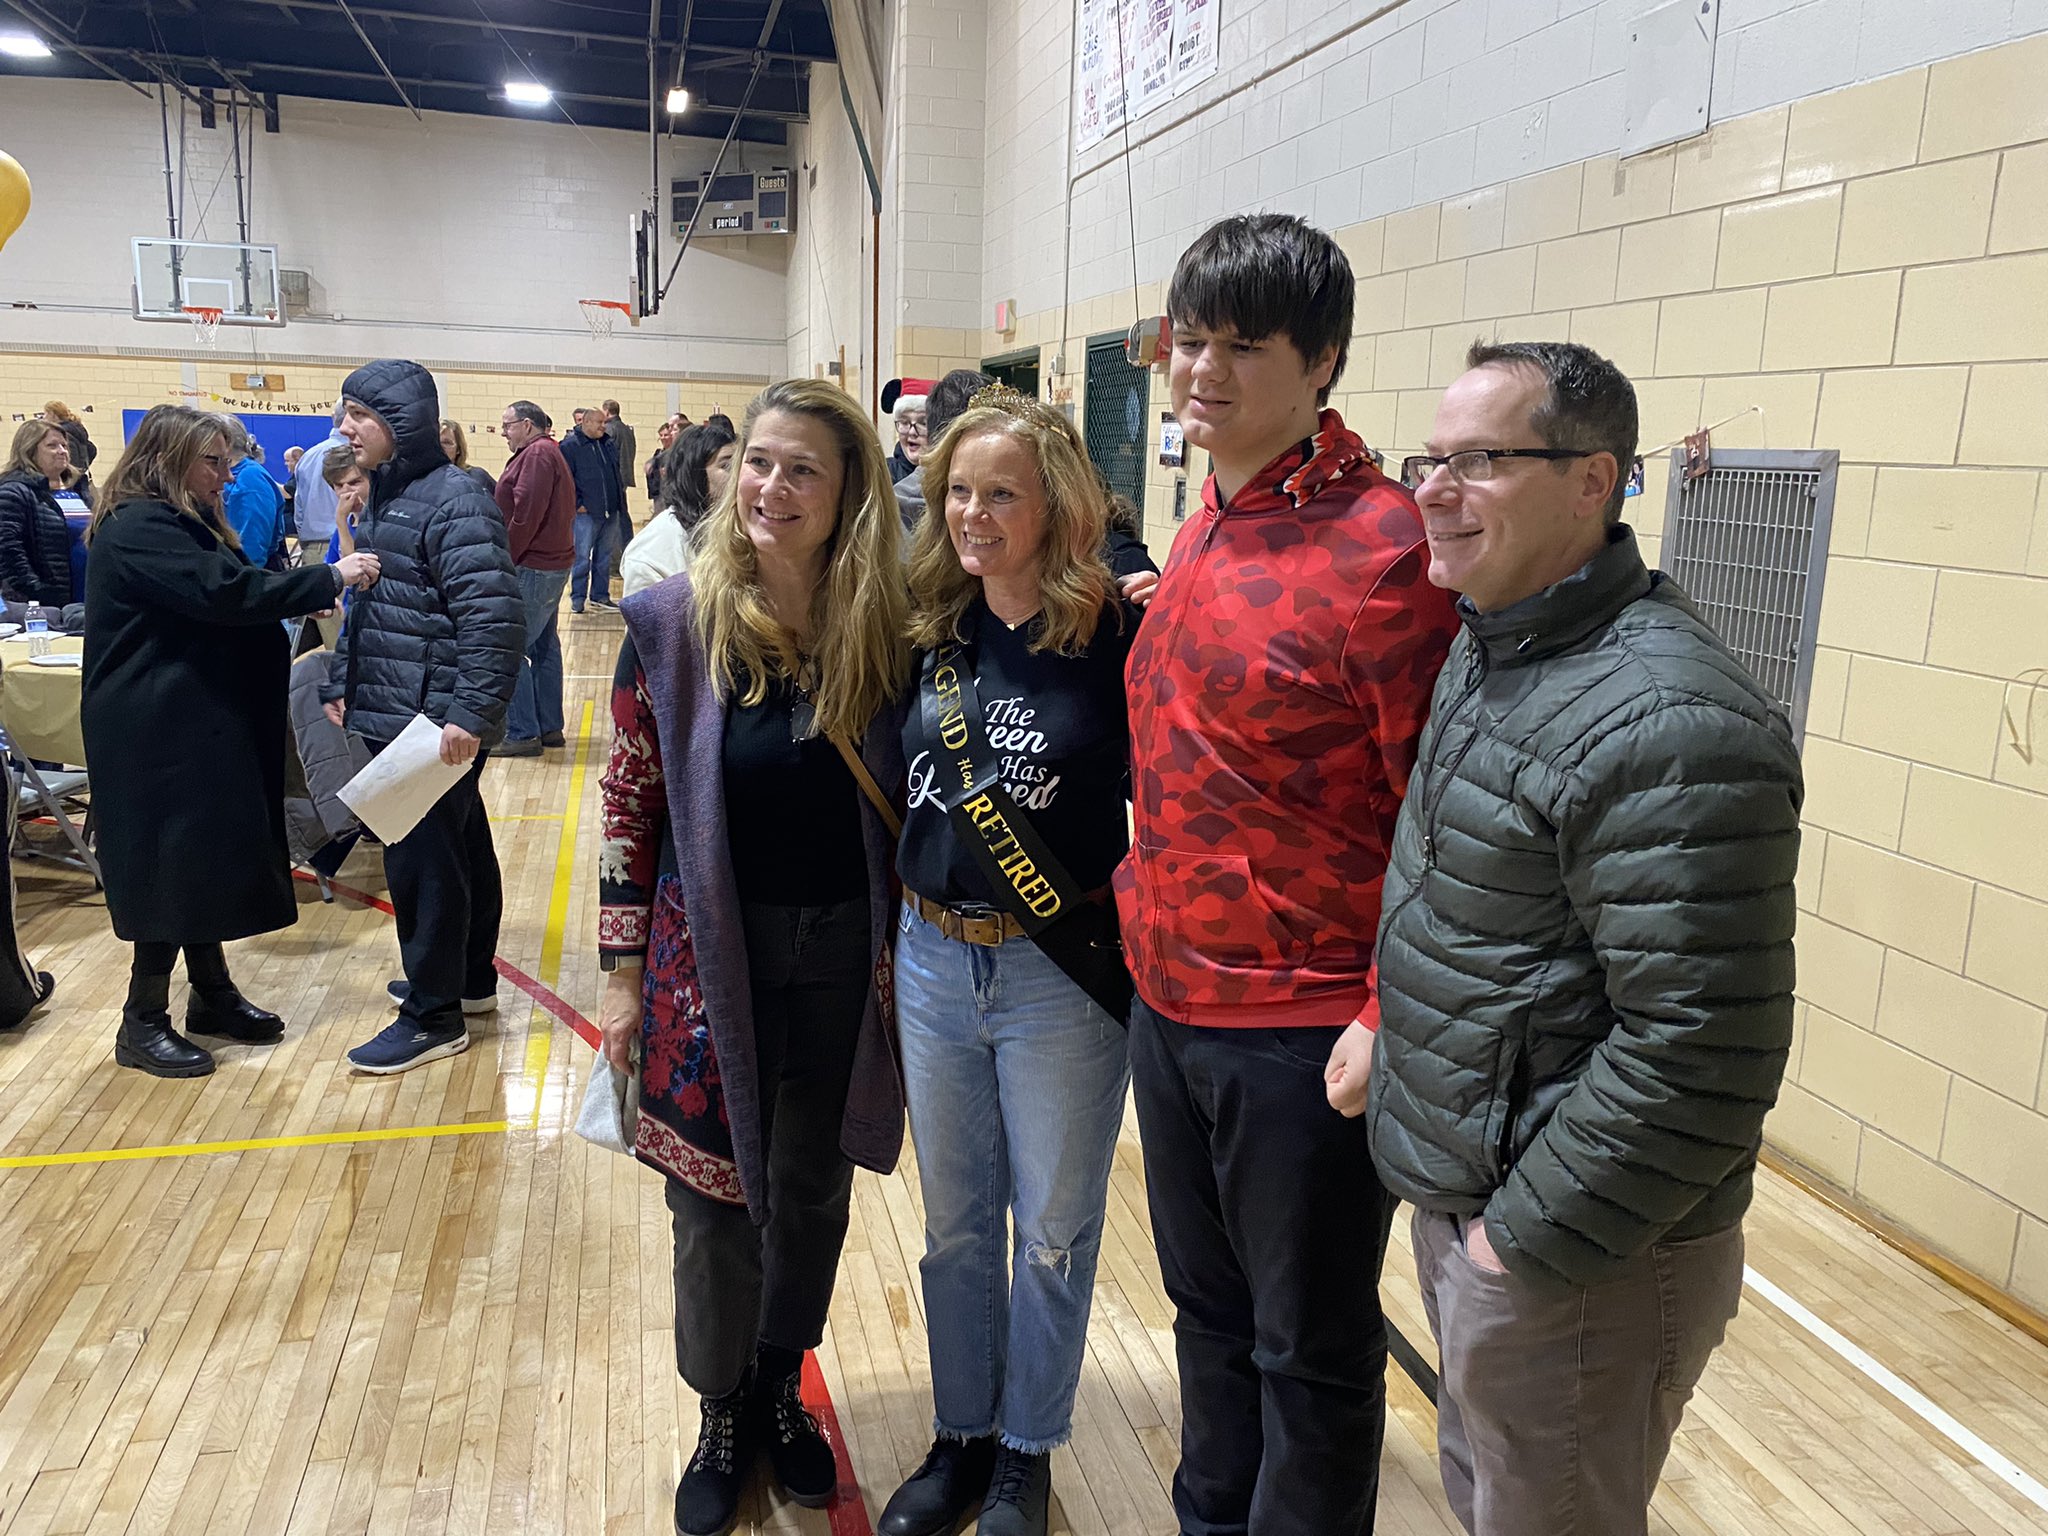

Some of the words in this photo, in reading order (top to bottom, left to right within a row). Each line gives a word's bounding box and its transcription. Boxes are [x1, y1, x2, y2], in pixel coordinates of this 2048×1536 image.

[760, 177, 785, 188] Guests
[716, 216, 739, 229] period
[223, 397, 238, 405] we
[241, 400, 272, 411] will
[278, 402, 300, 413] miss
[311, 401, 333, 413] you
[935, 646, 969, 750] GEND
[985, 697, 1036, 725] The
[985, 725, 1048, 754] een
[957, 758, 974, 790] Has
[999, 756, 1048, 782] Has
[962, 793, 1062, 918] RETIRED
